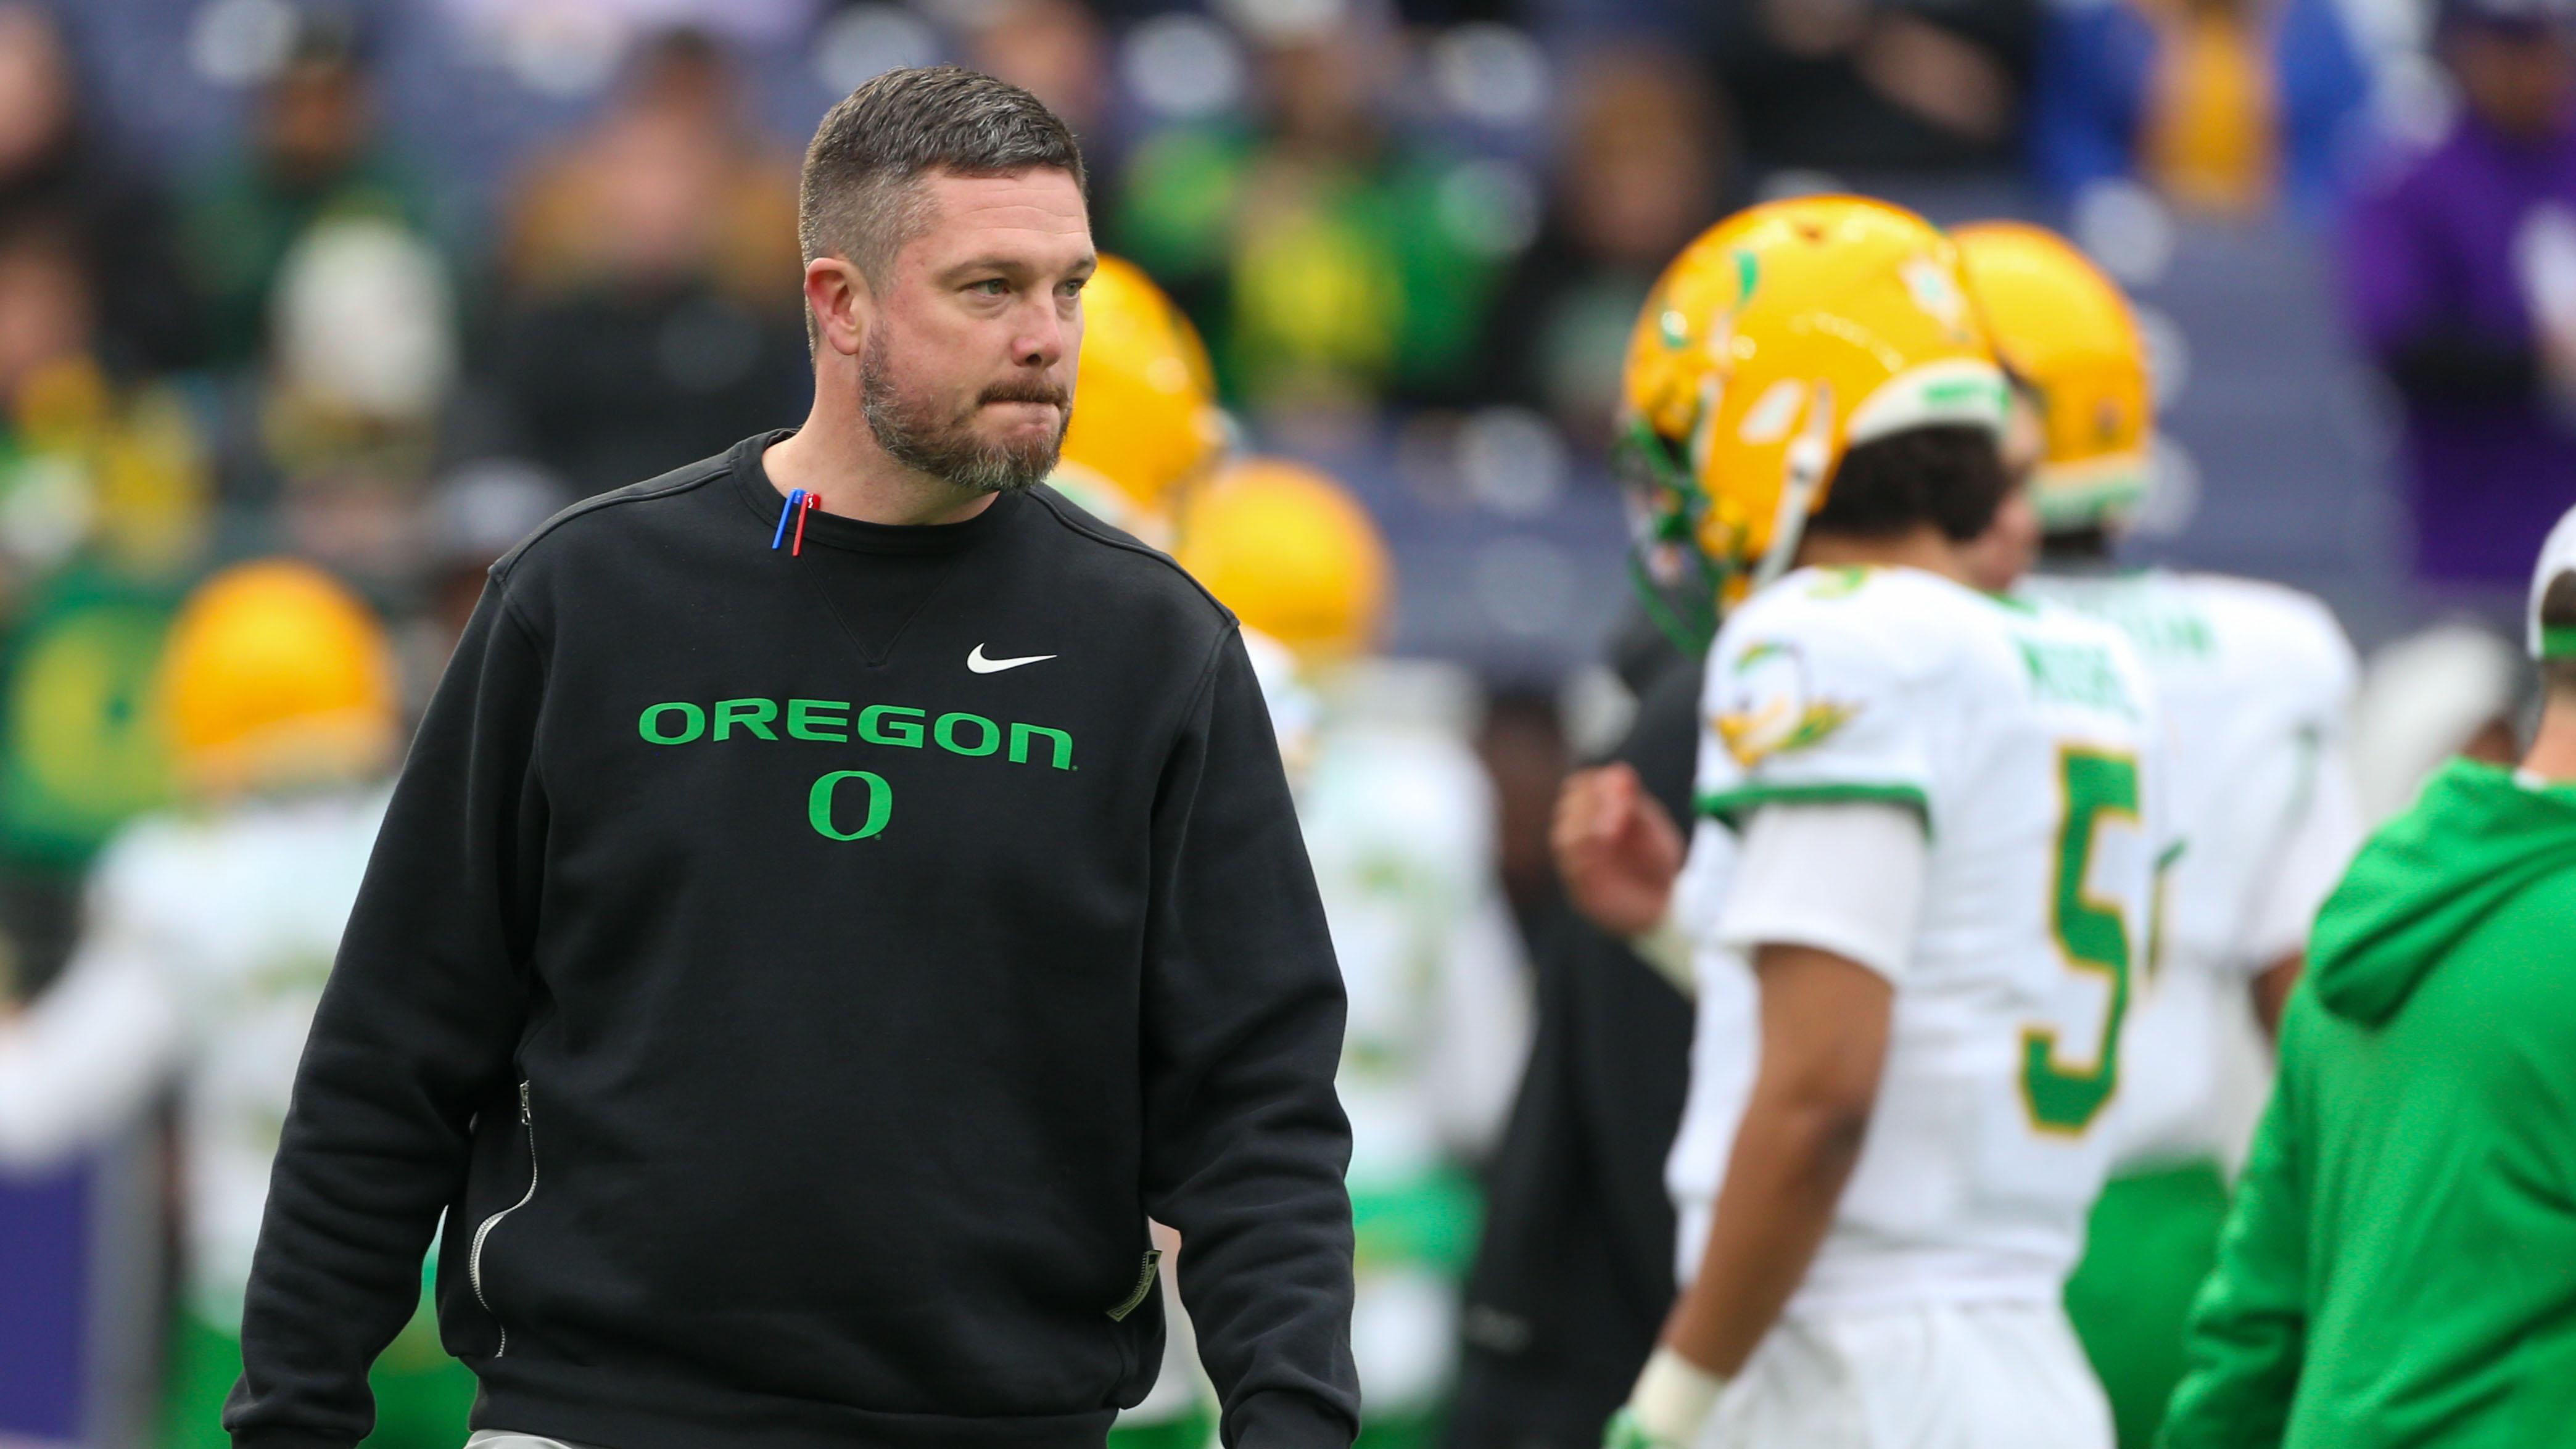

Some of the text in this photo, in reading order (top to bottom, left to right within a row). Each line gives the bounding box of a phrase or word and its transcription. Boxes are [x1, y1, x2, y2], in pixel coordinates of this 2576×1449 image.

[638, 698, 1074, 770] OREGON
[807, 770, 894, 842] O
[2018, 743, 2142, 1138] 5
